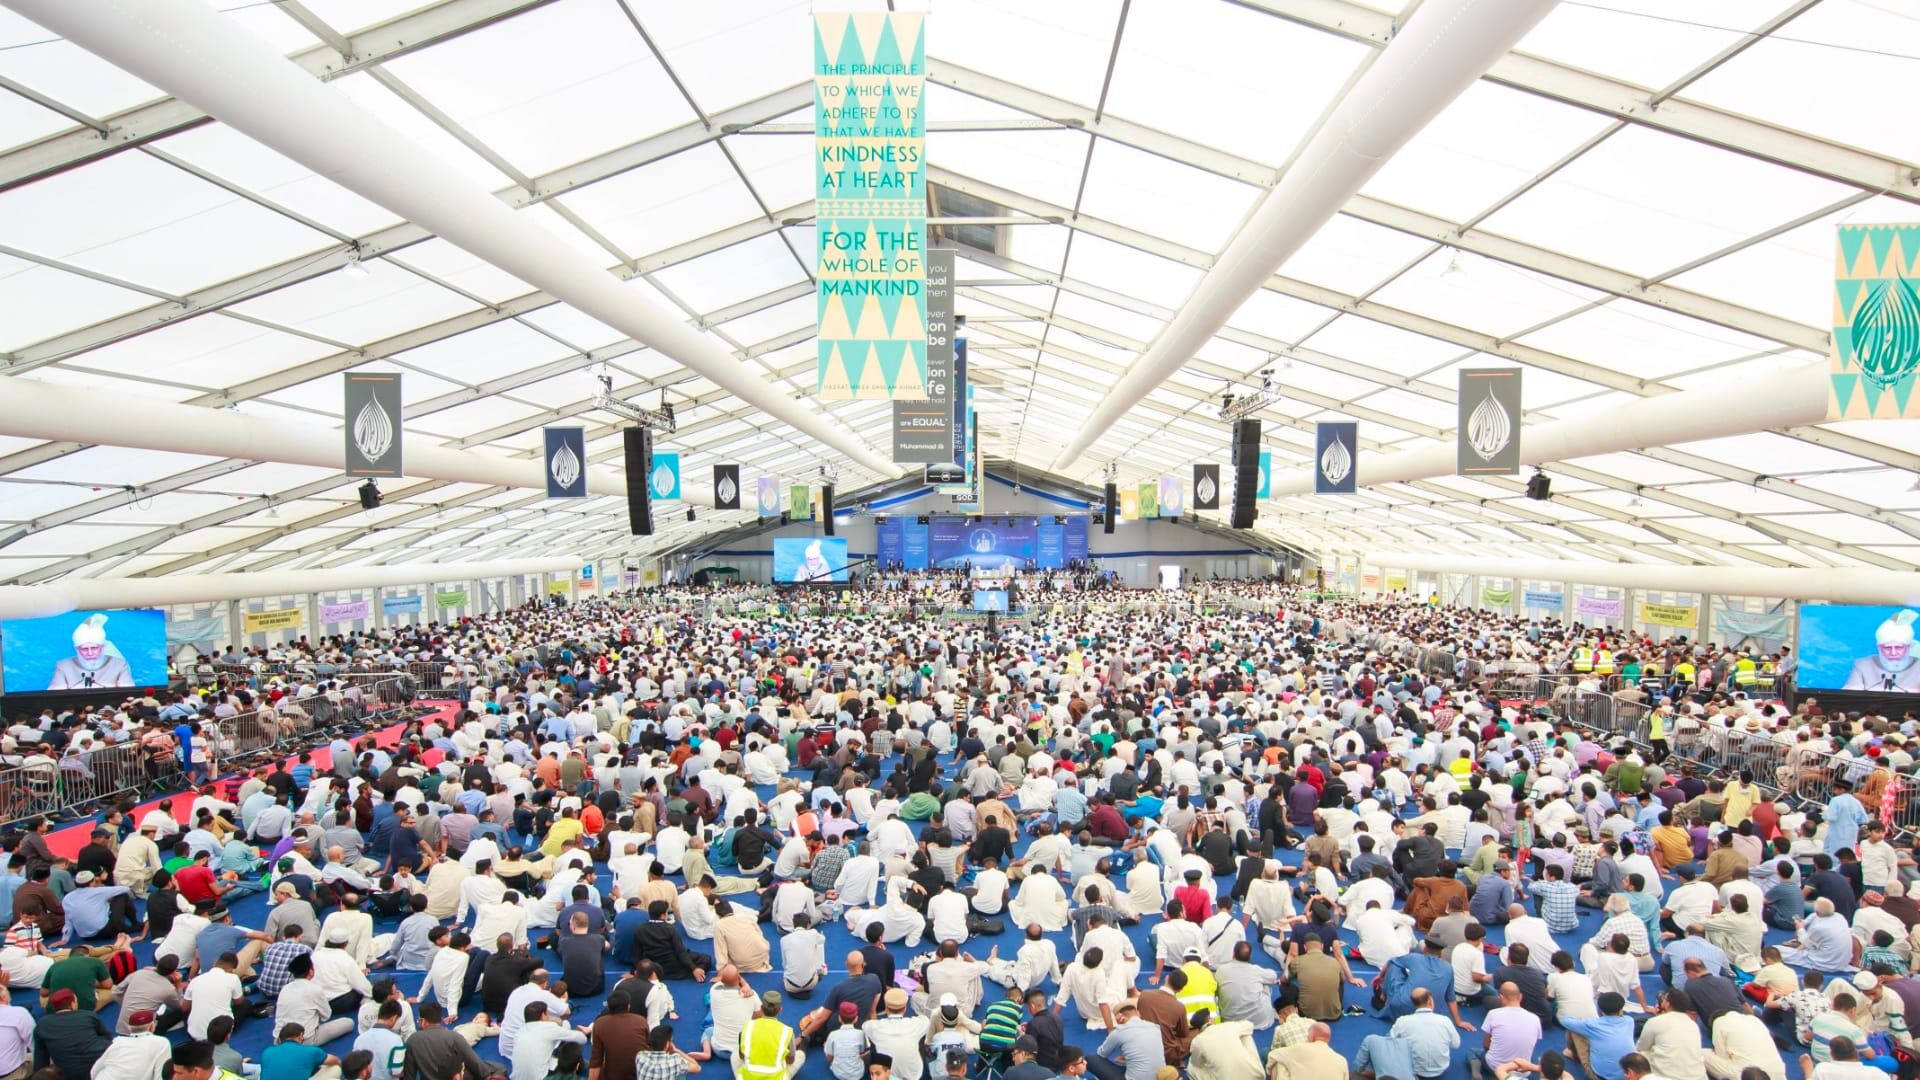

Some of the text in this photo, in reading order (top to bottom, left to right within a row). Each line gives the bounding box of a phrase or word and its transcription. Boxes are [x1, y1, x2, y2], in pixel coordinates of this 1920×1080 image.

[822, 64, 918, 75] THE PRINCIPLE
[822, 85, 918, 97] TO WHICH WE
[822, 107, 918, 119] ADHERE TO IS
[823, 127, 917, 137] THAT WE HAVE
[822, 145, 918, 162] KINDNESS
[822, 171, 918, 188] AT HEART
[822, 231, 919, 250] FOR THE
[823, 258, 919, 272] WHOLE OF
[929, 265, 947, 274] you
[822, 280, 919, 296] MANKIND
